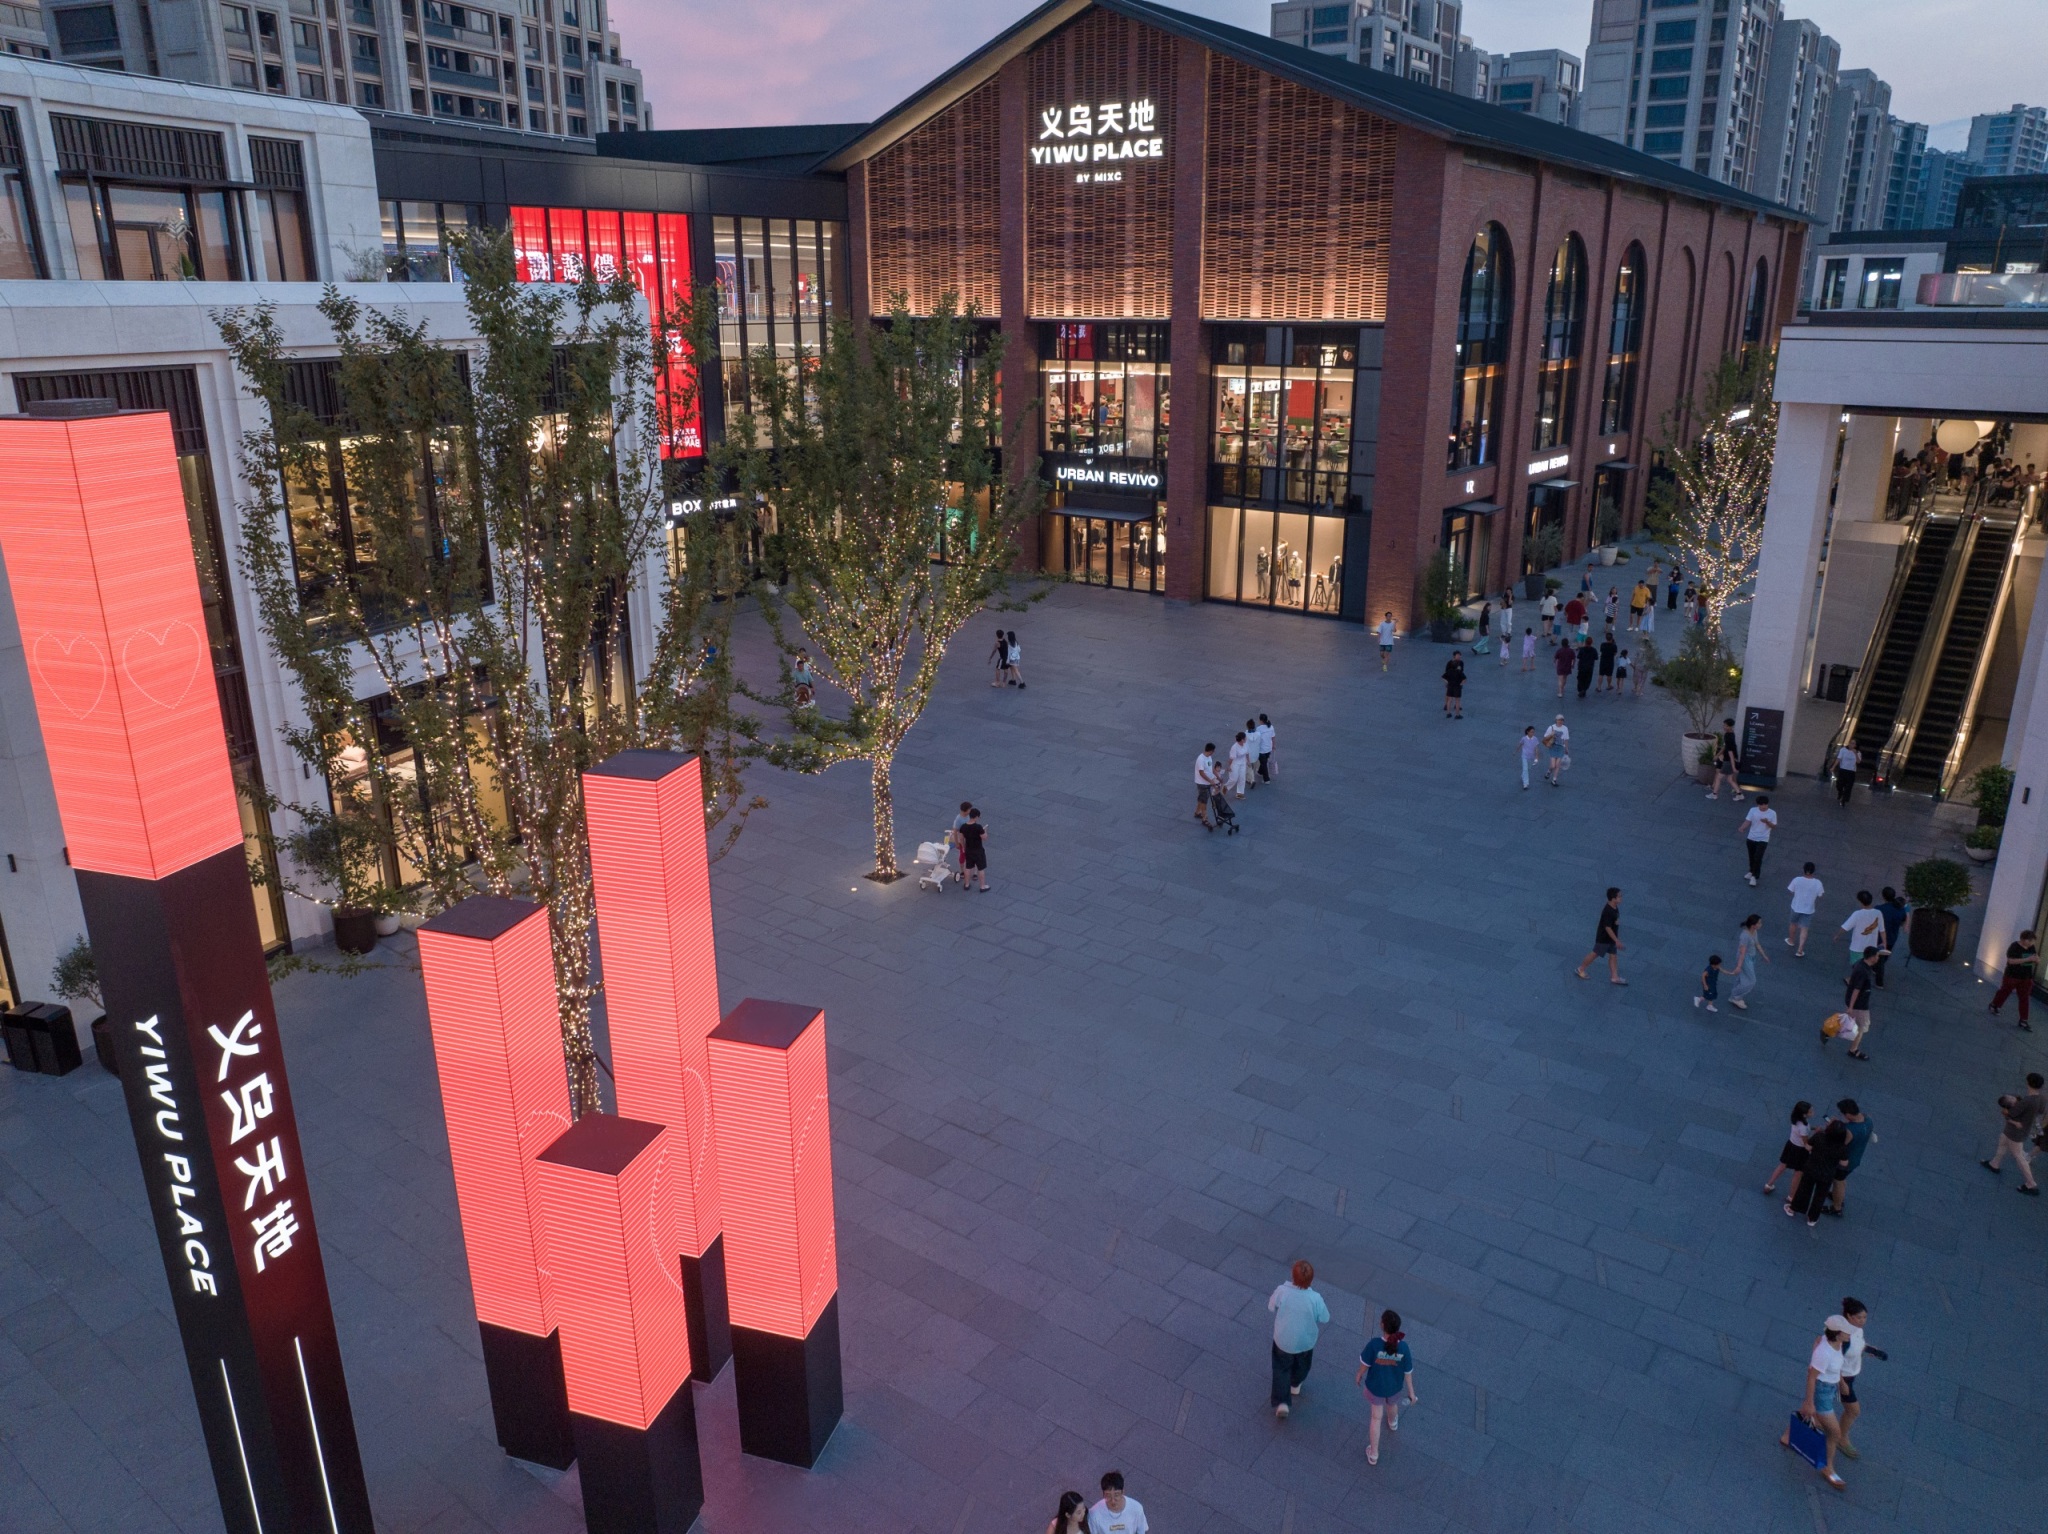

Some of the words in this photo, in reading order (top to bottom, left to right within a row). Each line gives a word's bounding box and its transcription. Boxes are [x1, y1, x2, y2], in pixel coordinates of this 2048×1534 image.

[1040, 98, 1155, 140] 义乌天地
[1031, 144, 1088, 164] YIWU
[1093, 138, 1163, 161] PLACE
[1076, 173, 1090, 183] BY
[1095, 171, 1122, 182] MIXC
[1057, 467, 1104, 482] URBAN
[1109, 472, 1159, 487] REVIVO
[672, 500, 702, 516] BOX
[208, 1009, 300, 1274] 义乌天地
[136, 1014, 183, 1141] YIWU
[164, 1153, 218, 1296] PLACE
